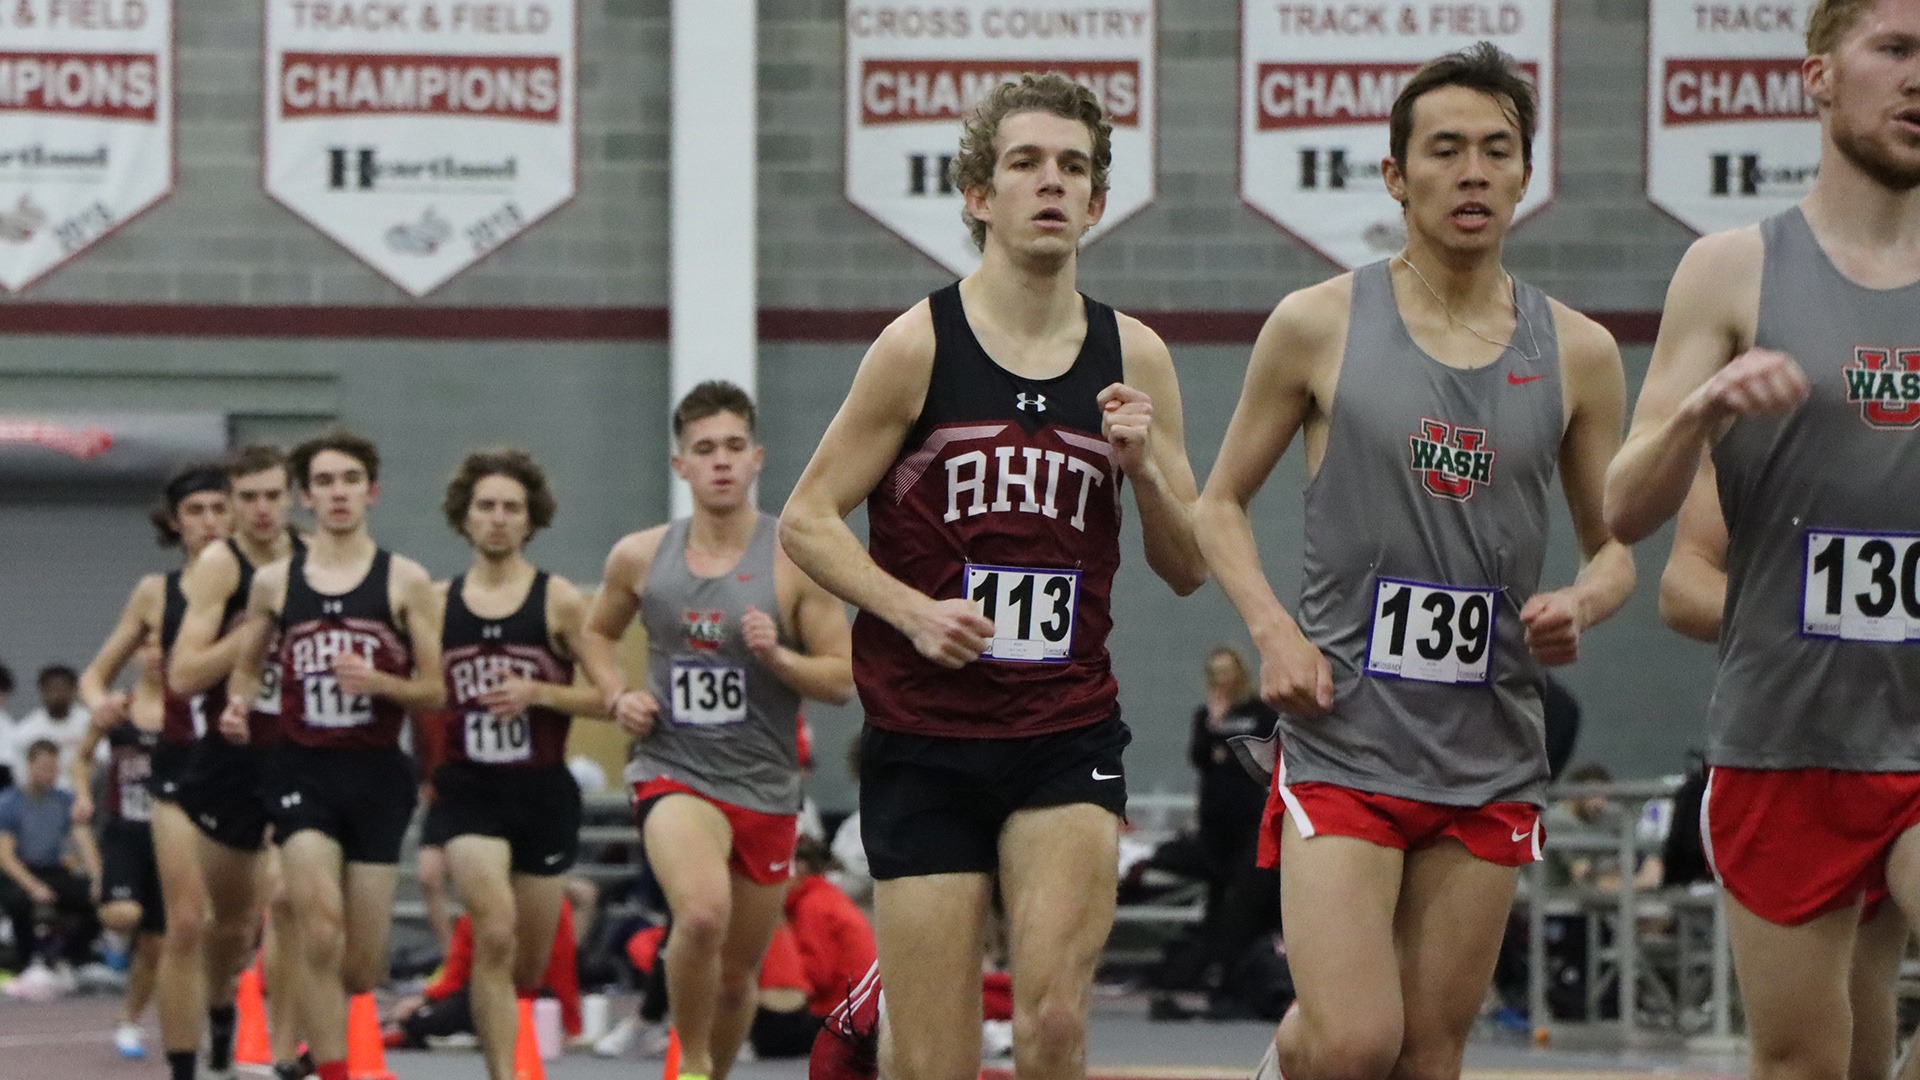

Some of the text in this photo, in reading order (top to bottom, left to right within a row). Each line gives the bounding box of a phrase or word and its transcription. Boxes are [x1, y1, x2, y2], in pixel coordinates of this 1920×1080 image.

[291, 3, 551, 34] TRACK & FIELD
[850, 8, 1150, 39] CROSS COUNTRY
[1277, 6, 1523, 35] TRACK & FIELD
[1694, 5, 1796, 33] TRACK
[283, 62, 559, 112] CHAMPIONS
[1410, 436, 1494, 485] WASH
[943, 446, 1105, 532] RHIT
[973, 571, 1071, 642] 113
[1381, 586, 1490, 665] 139
[451, 656, 539, 704] RHT
[677, 671, 742, 711] 136
[471, 717, 525, 751] 110
